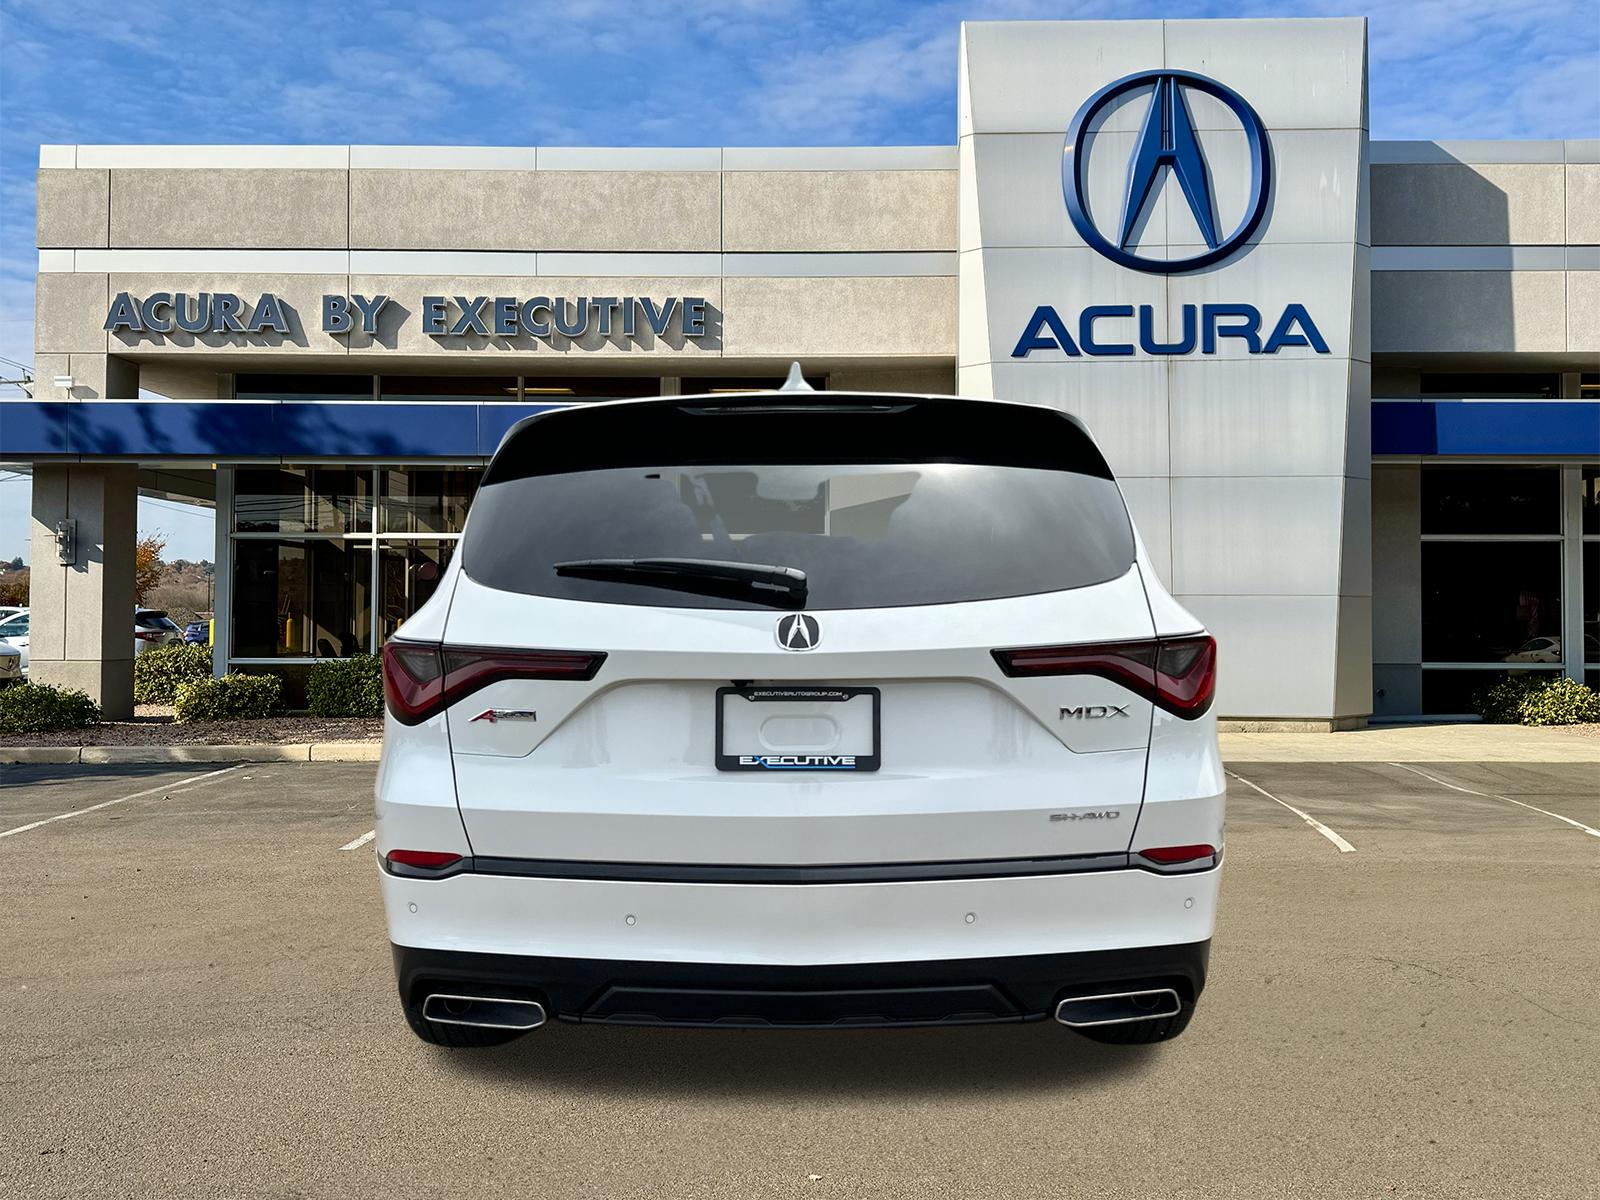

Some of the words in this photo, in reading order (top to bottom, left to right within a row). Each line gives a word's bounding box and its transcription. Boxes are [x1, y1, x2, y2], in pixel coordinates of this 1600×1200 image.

[104, 292, 288, 334] ACURA
[321, 294, 391, 335] BY
[421, 295, 707, 337] EXECUTIVE
[1011, 303, 1331, 357] ACURA
[1059, 704, 1130, 720] MDX
[739, 756, 856, 768] EXECUTIVE
